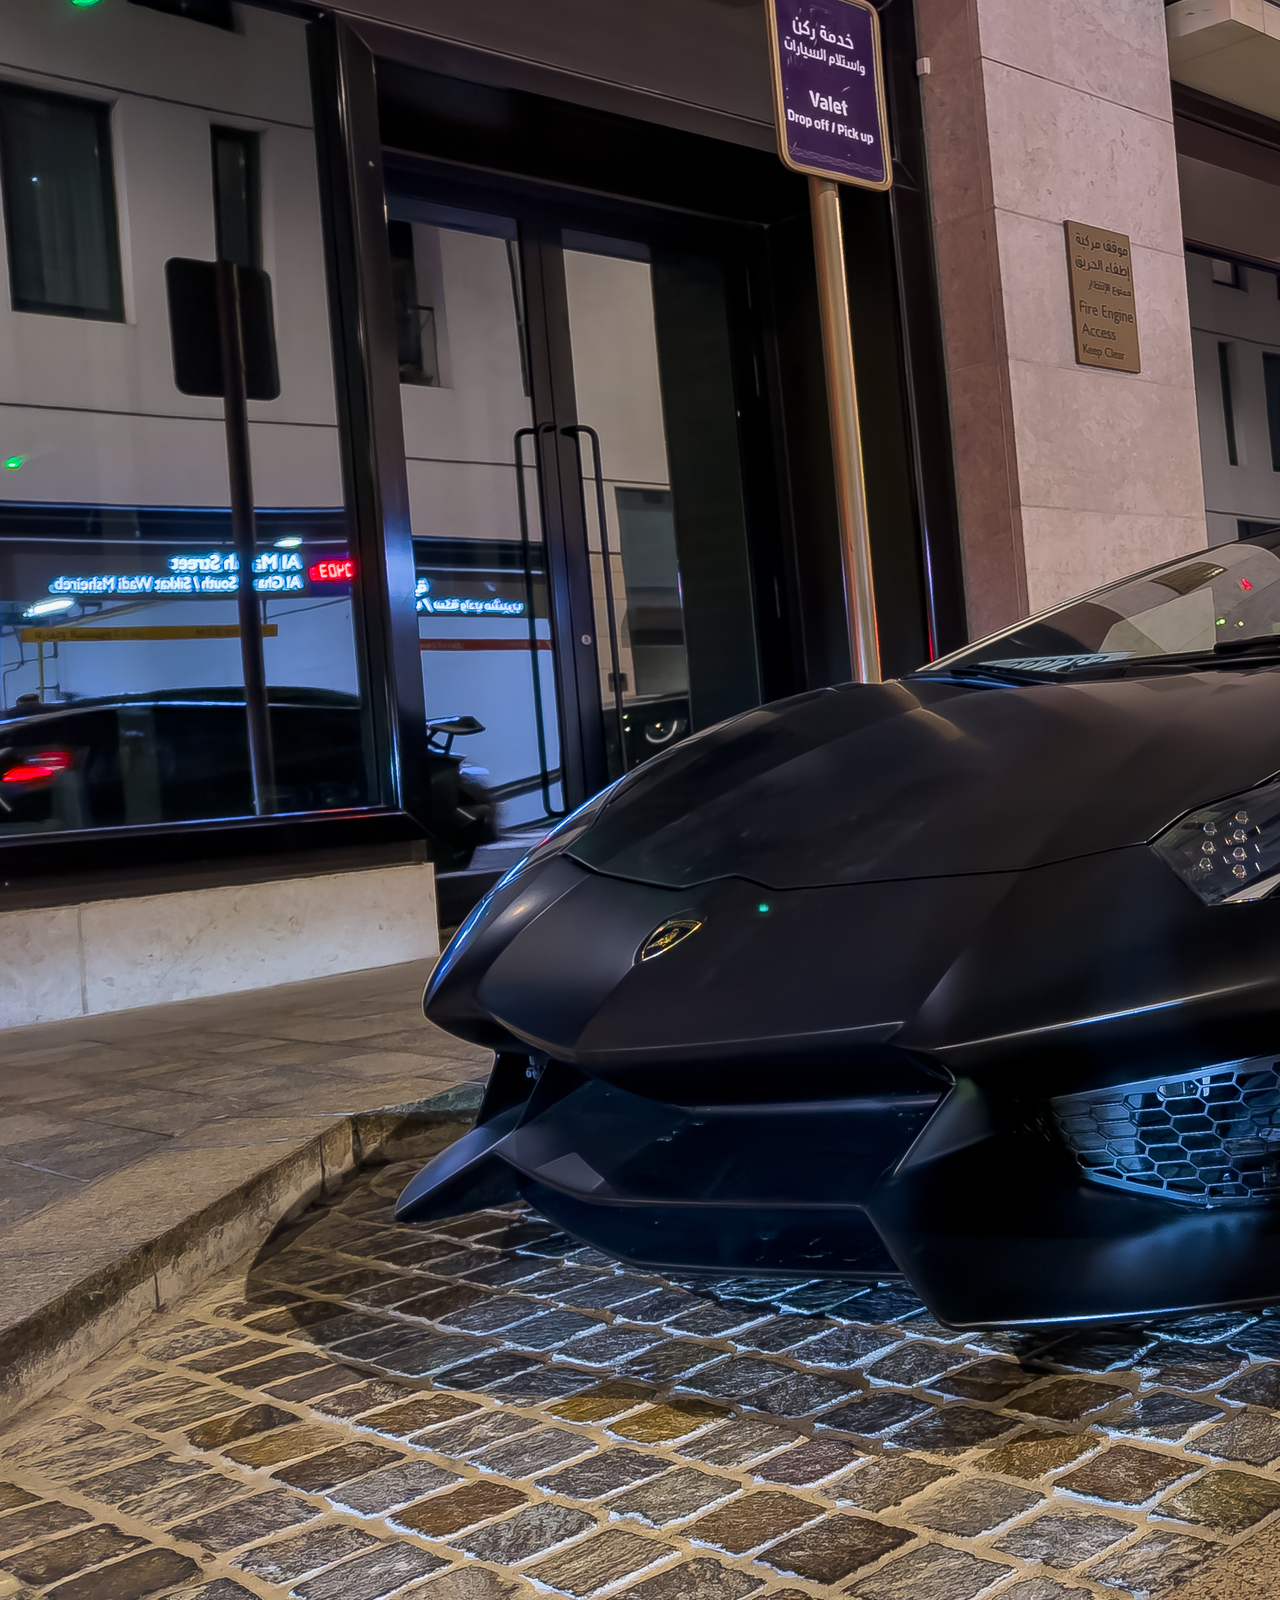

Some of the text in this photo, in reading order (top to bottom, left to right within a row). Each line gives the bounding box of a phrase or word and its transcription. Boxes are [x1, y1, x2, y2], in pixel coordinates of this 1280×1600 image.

[792, 16, 854, 50] خدمة ركن
[784, 36, 866, 76] واستلام السيارات
[809, 90, 848, 116] Valet
[787, 109, 874, 145] Drop off / Pick up
[1075, 232, 1128, 258] موقف مركبة
[1075, 255, 1130, 281] إطفاء الحريق
[1079, 300, 1133, 324] Fire Engine
[1082, 323, 1116, 341] Access
[1082, 344, 1125, 360] Keep Clear
